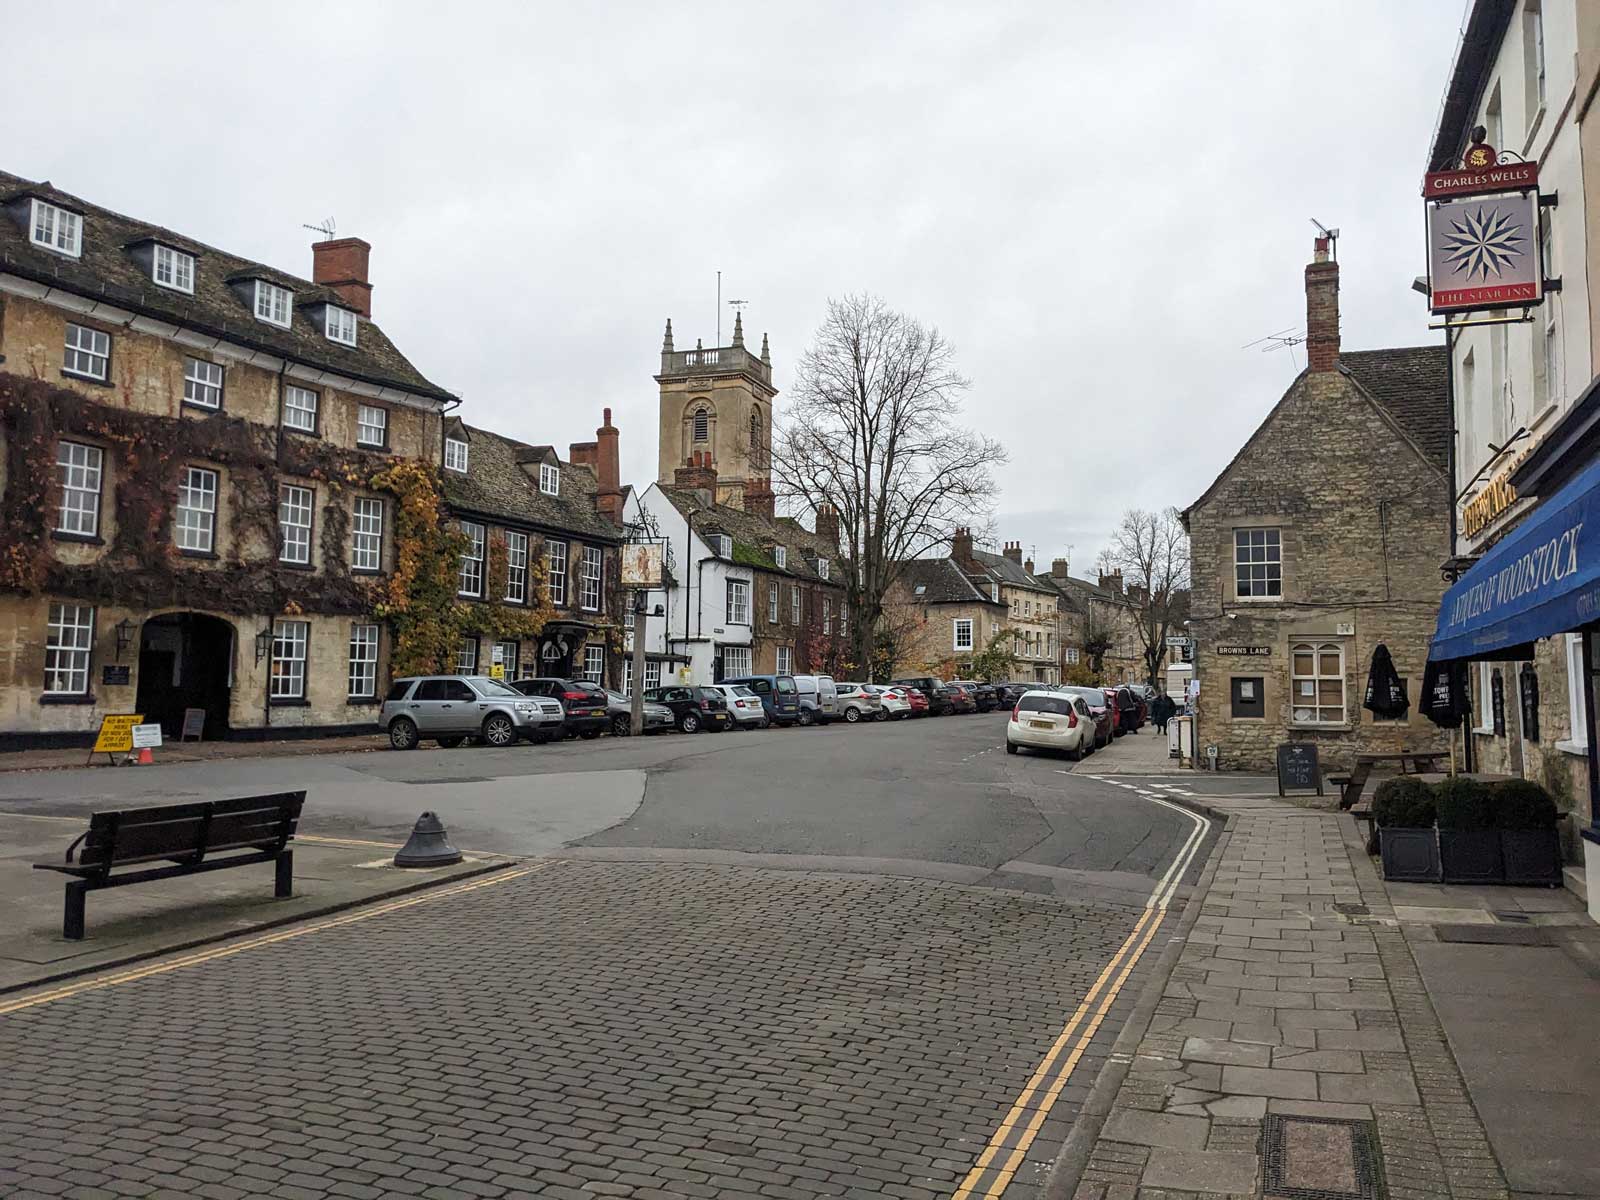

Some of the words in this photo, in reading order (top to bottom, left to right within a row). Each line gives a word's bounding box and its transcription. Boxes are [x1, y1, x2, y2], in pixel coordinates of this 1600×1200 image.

[1434, 174, 1487, 189] CHARLES
[1490, 170, 1529, 181] WELLS
[1441, 293, 1464, 304] THE
[1470, 290, 1501, 300] STAR
[1507, 287, 1531, 297] INN
[1482, 573, 1498, 613] OF
[1497, 522, 1583, 607] WOODSTOCK
[1249, 647, 1269, 655] LANE
